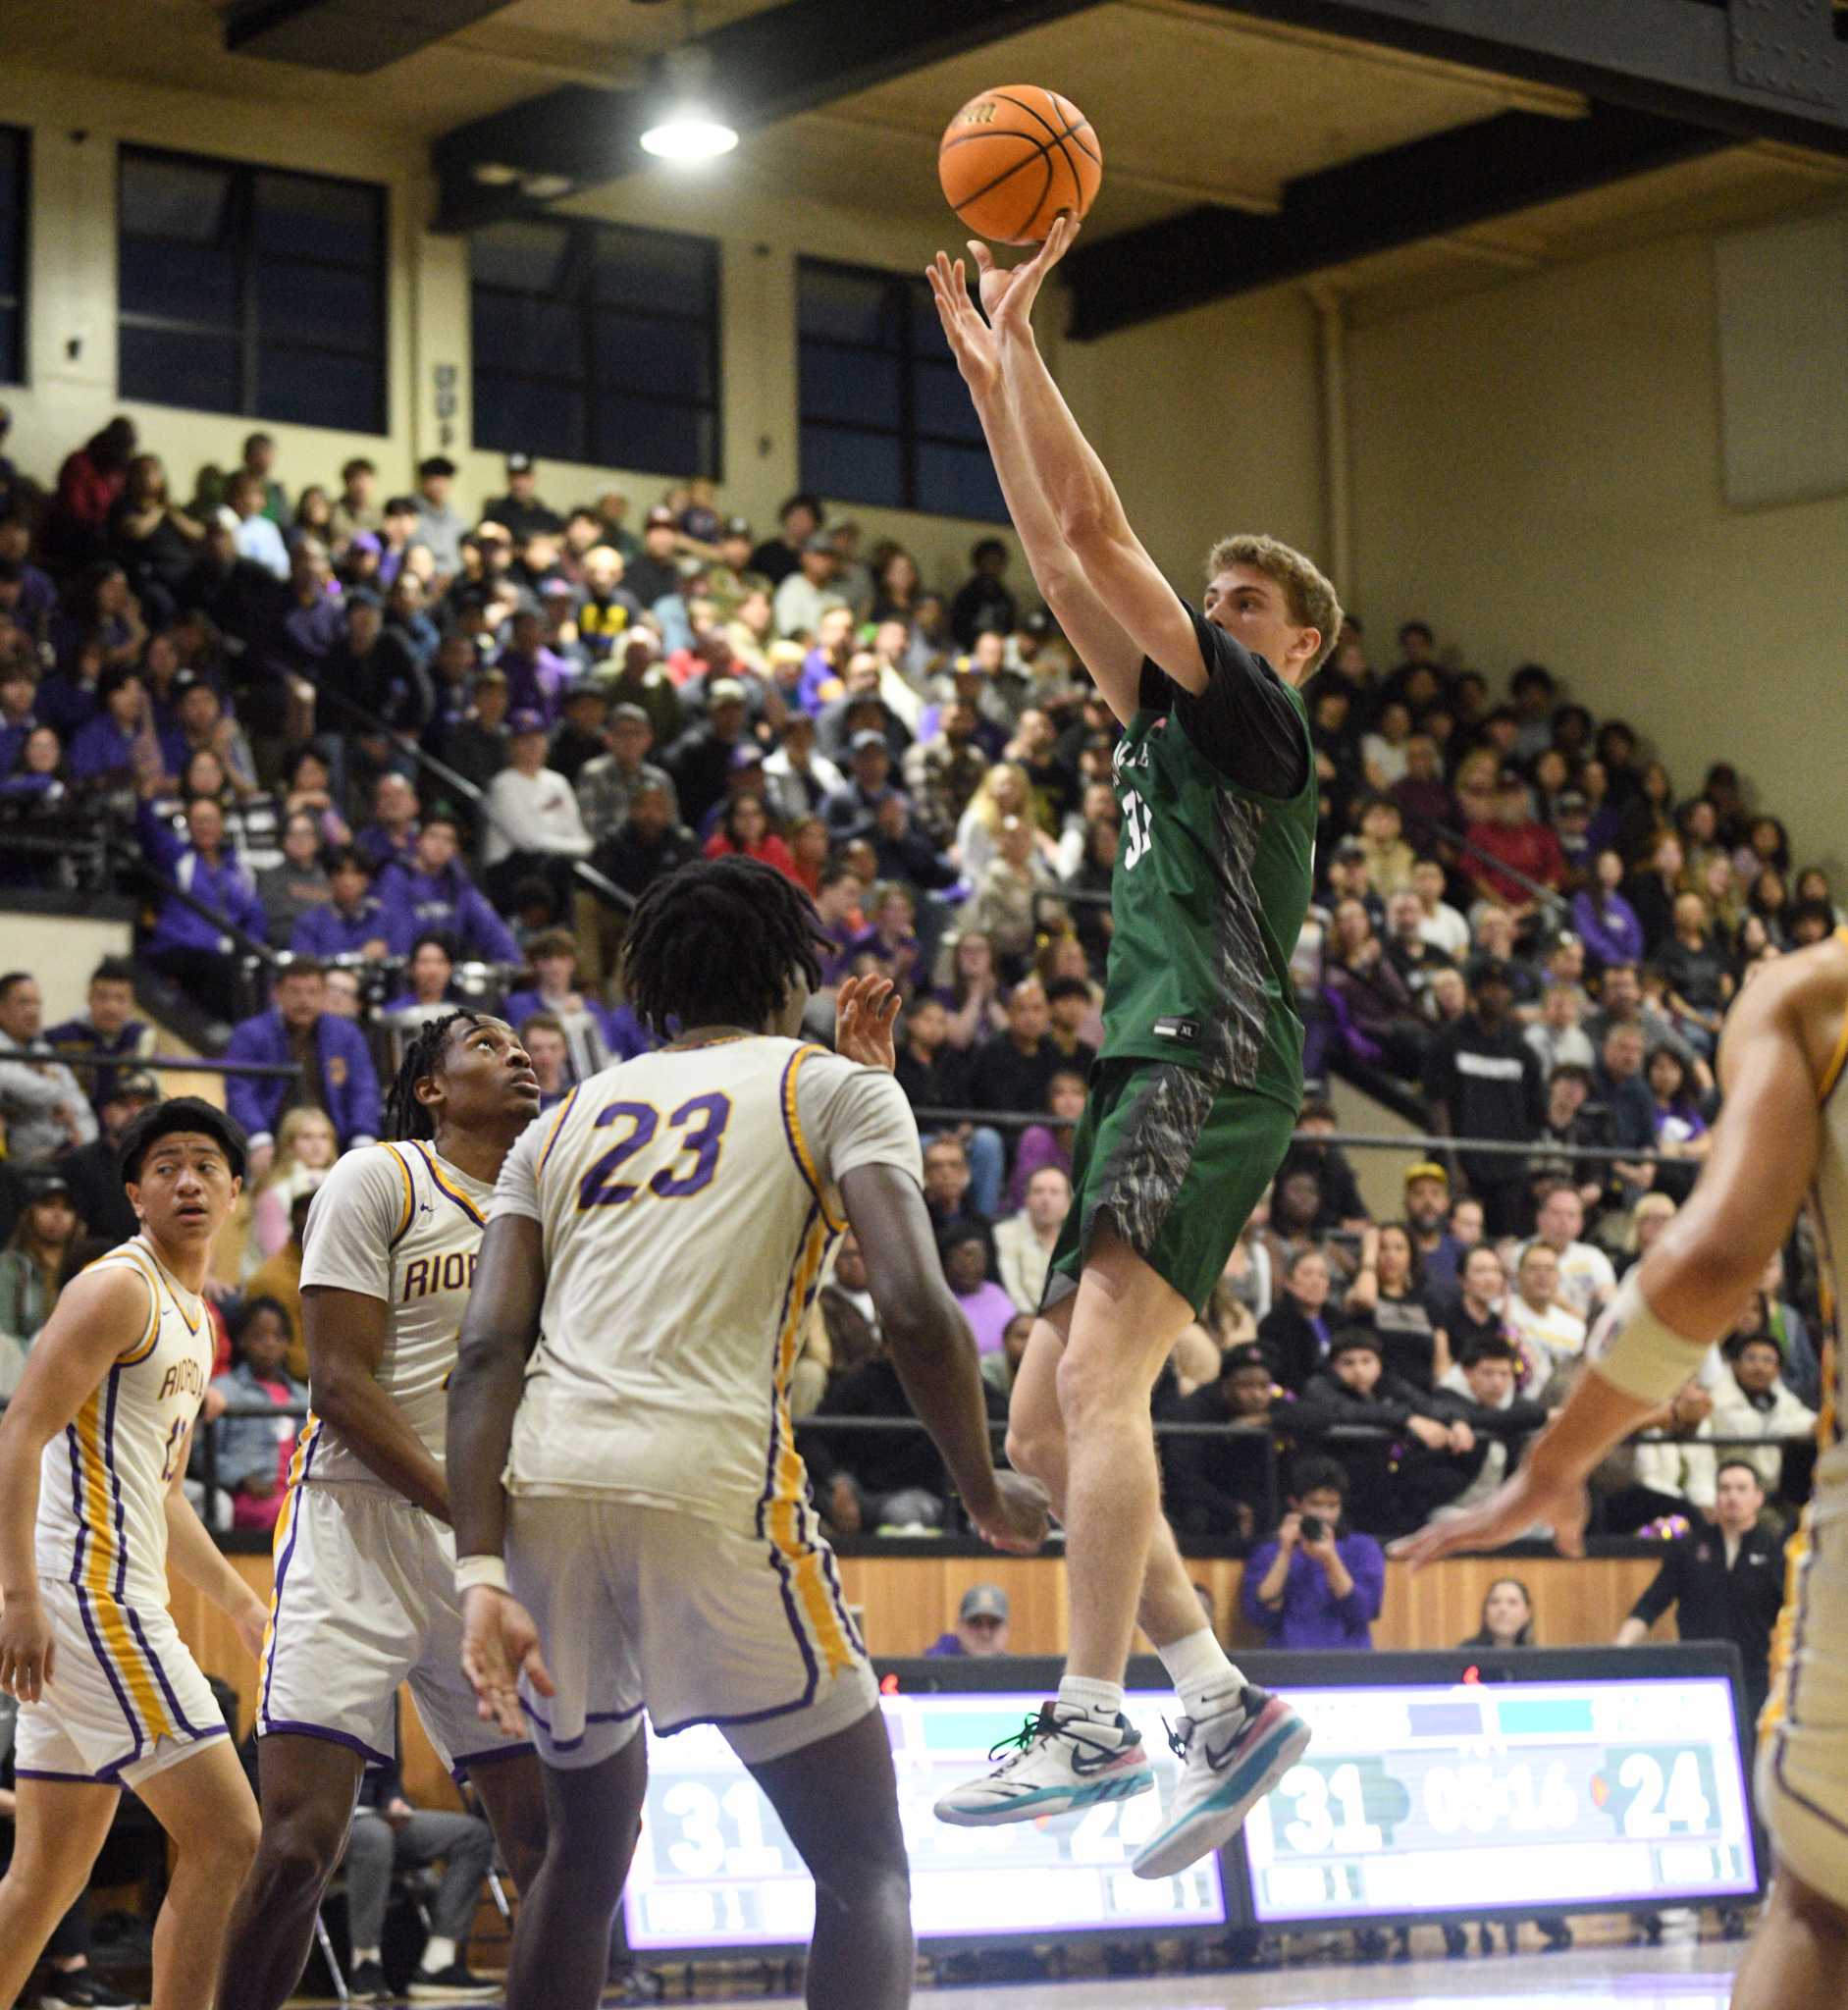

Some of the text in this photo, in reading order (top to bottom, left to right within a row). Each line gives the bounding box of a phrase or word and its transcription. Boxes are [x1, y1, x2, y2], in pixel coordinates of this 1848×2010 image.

[577, 1091, 732, 1210] 23
[663, 1780, 782, 1878] 31
[1281, 1765, 1382, 1853] 31
[1619, 1752, 1709, 1837] 24
